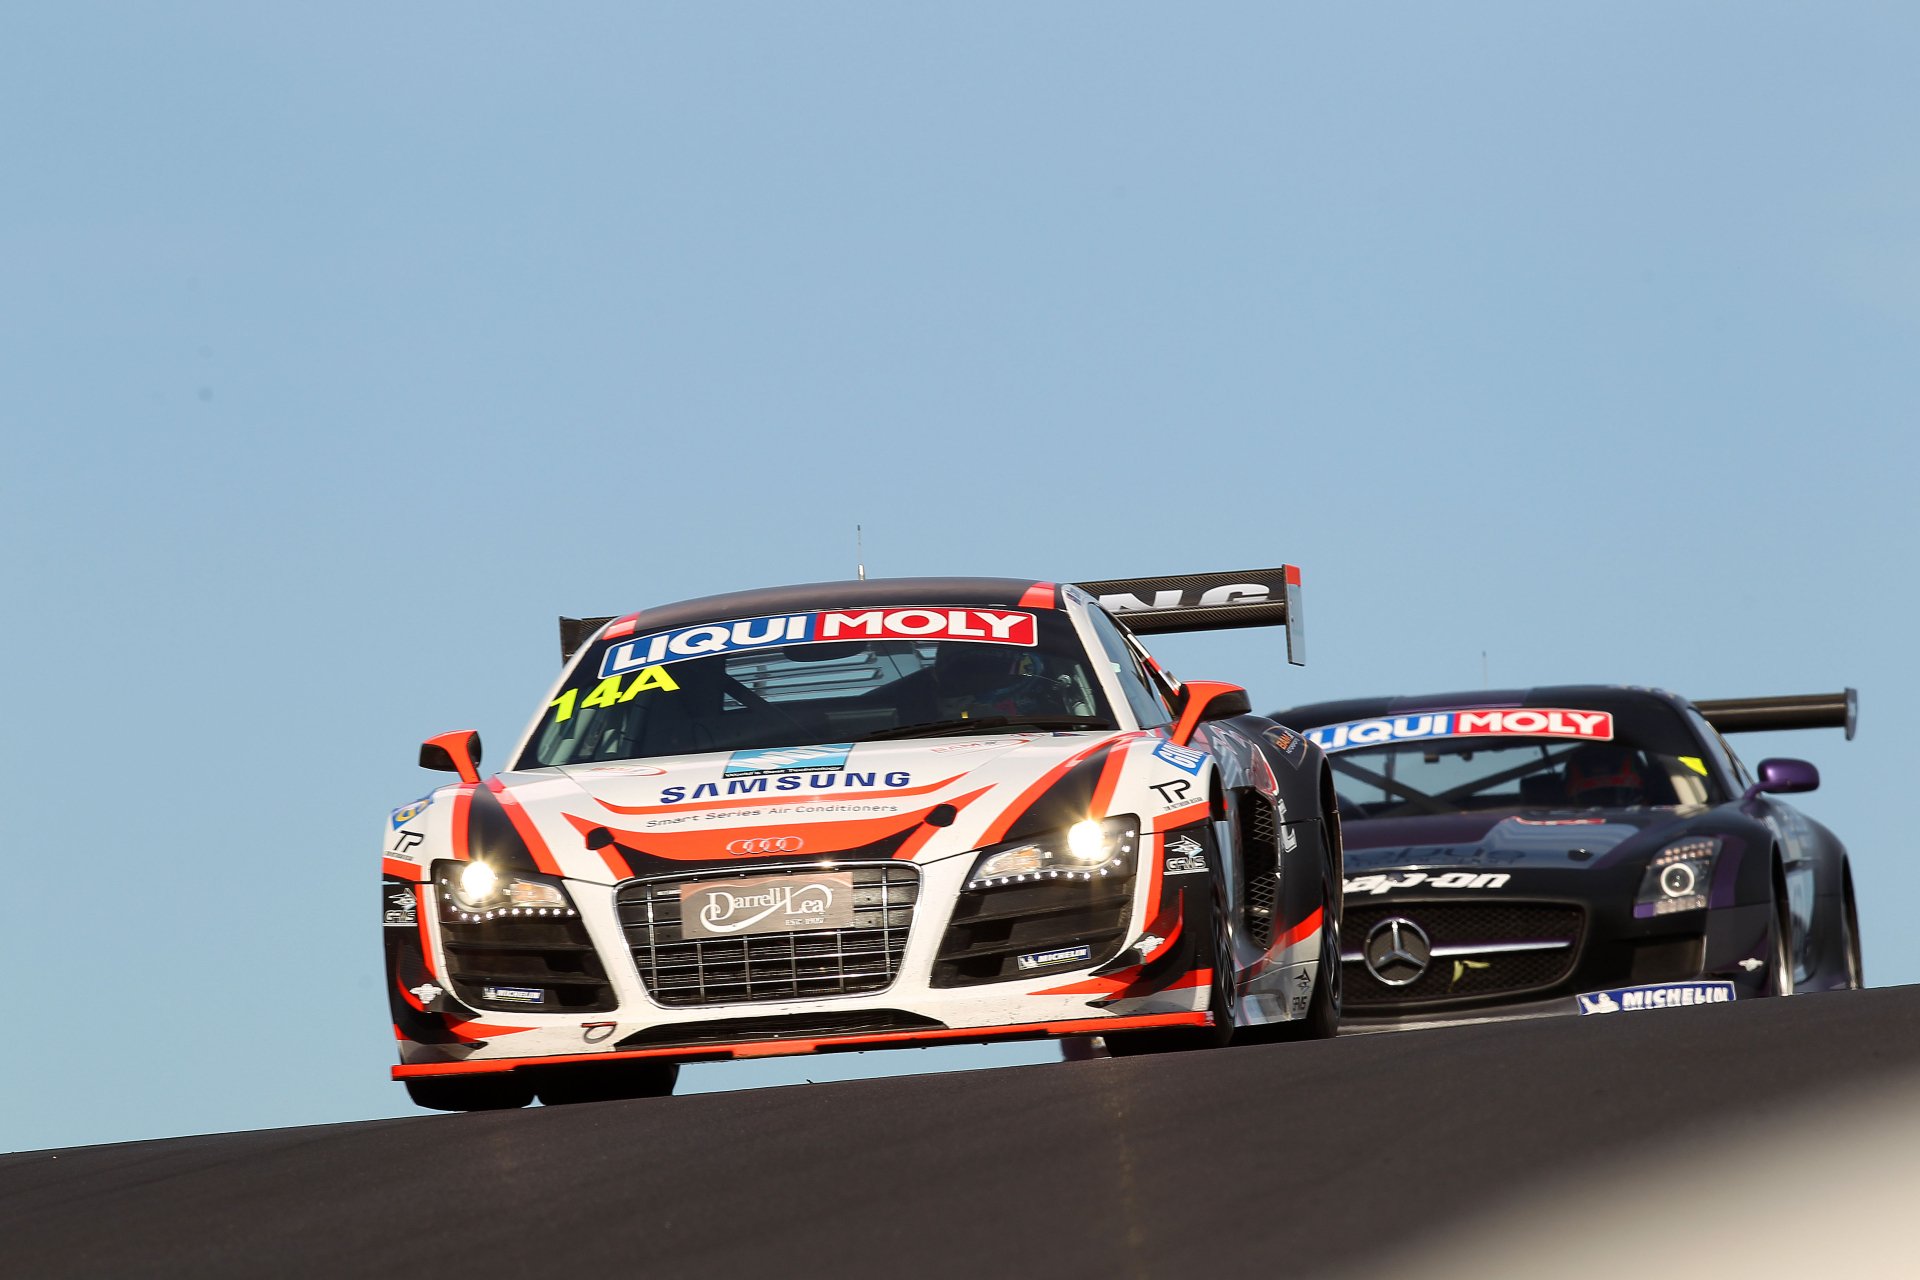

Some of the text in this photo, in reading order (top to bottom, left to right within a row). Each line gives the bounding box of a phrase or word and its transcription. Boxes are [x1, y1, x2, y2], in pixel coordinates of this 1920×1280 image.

[612, 609, 1026, 671] LIQUI MOLY
[549, 664, 680, 723] 14A
[1308, 714, 1448, 749] LIQUI
[1458, 711, 1608, 735] MOLY
[659, 771, 911, 804] SAMSUNG
[646, 805, 898, 828] Smart Series Air Conditioners
[1343, 873, 1511, 895] ap-on
[701, 885, 827, 926] Darrell Lea
[1622, 987, 1729, 1011] MICHELIN
